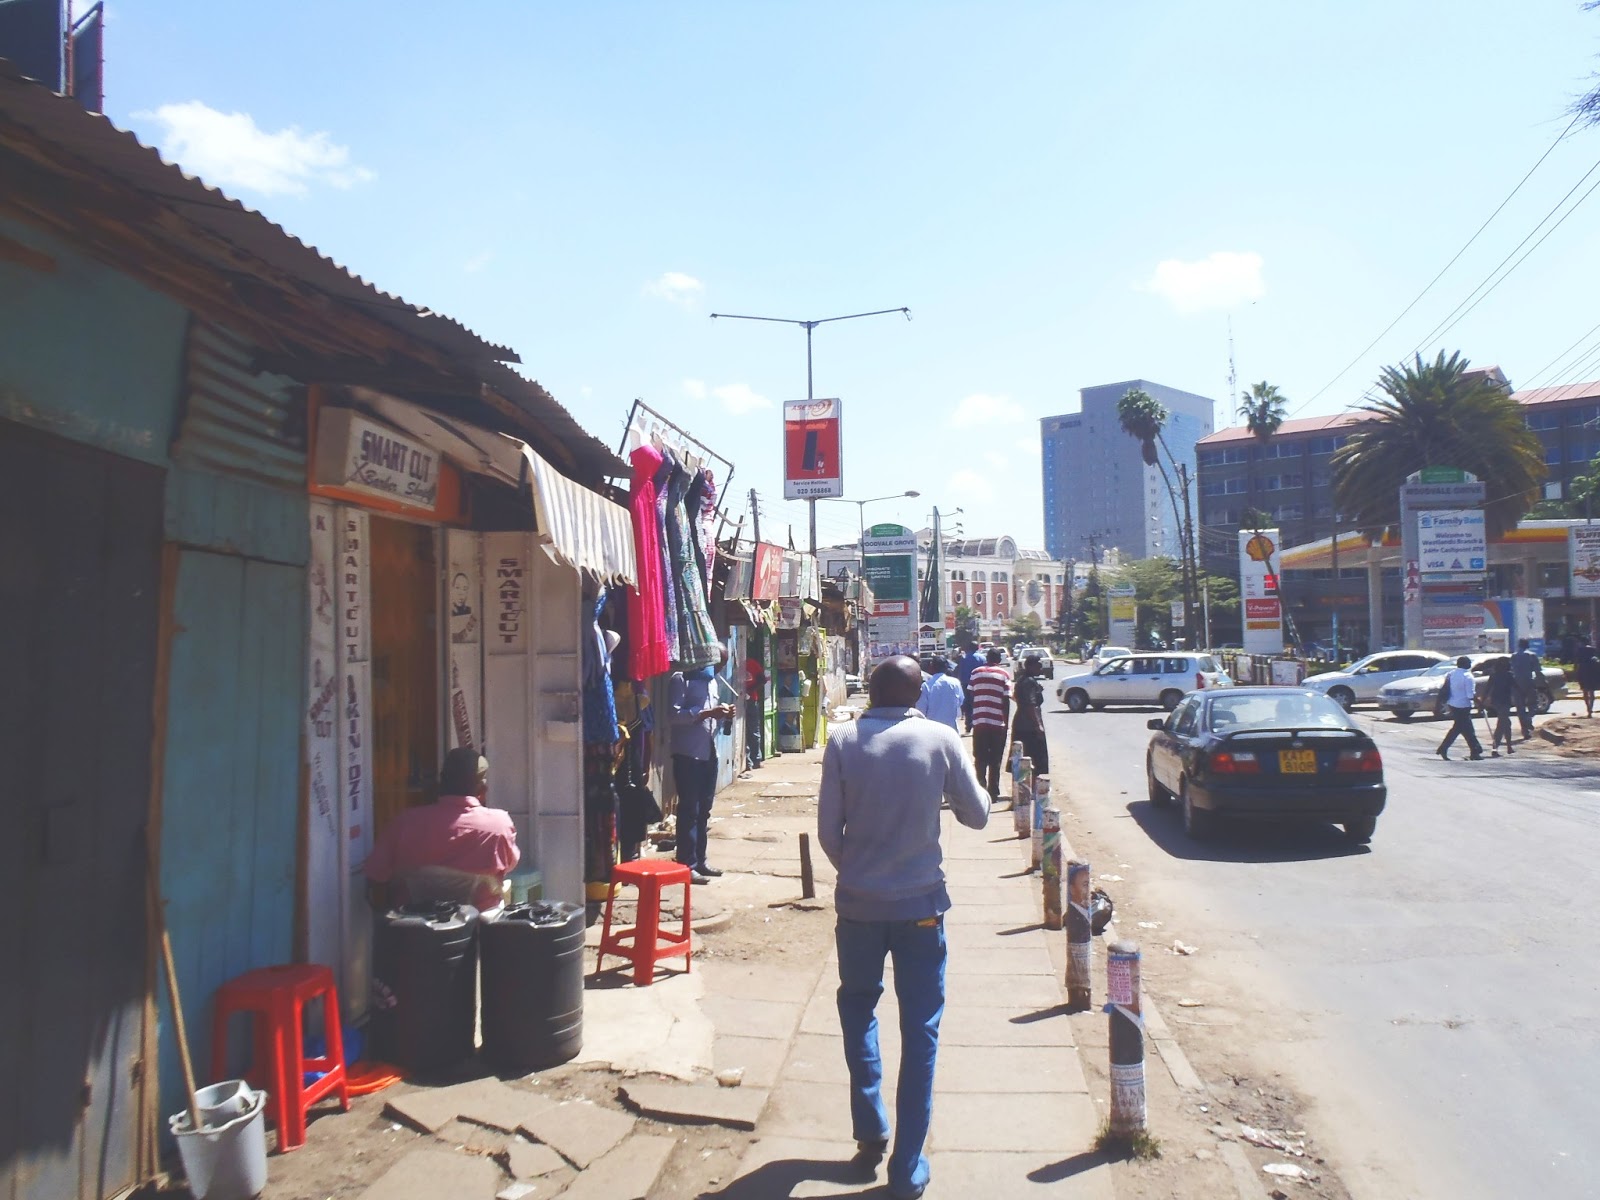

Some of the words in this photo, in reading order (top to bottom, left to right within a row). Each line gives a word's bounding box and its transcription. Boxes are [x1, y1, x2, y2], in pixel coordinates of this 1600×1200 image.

[360, 429, 409, 474] SMART
[1433, 517, 1463, 525] Family
[497, 558, 523, 643] SMARTCUT
